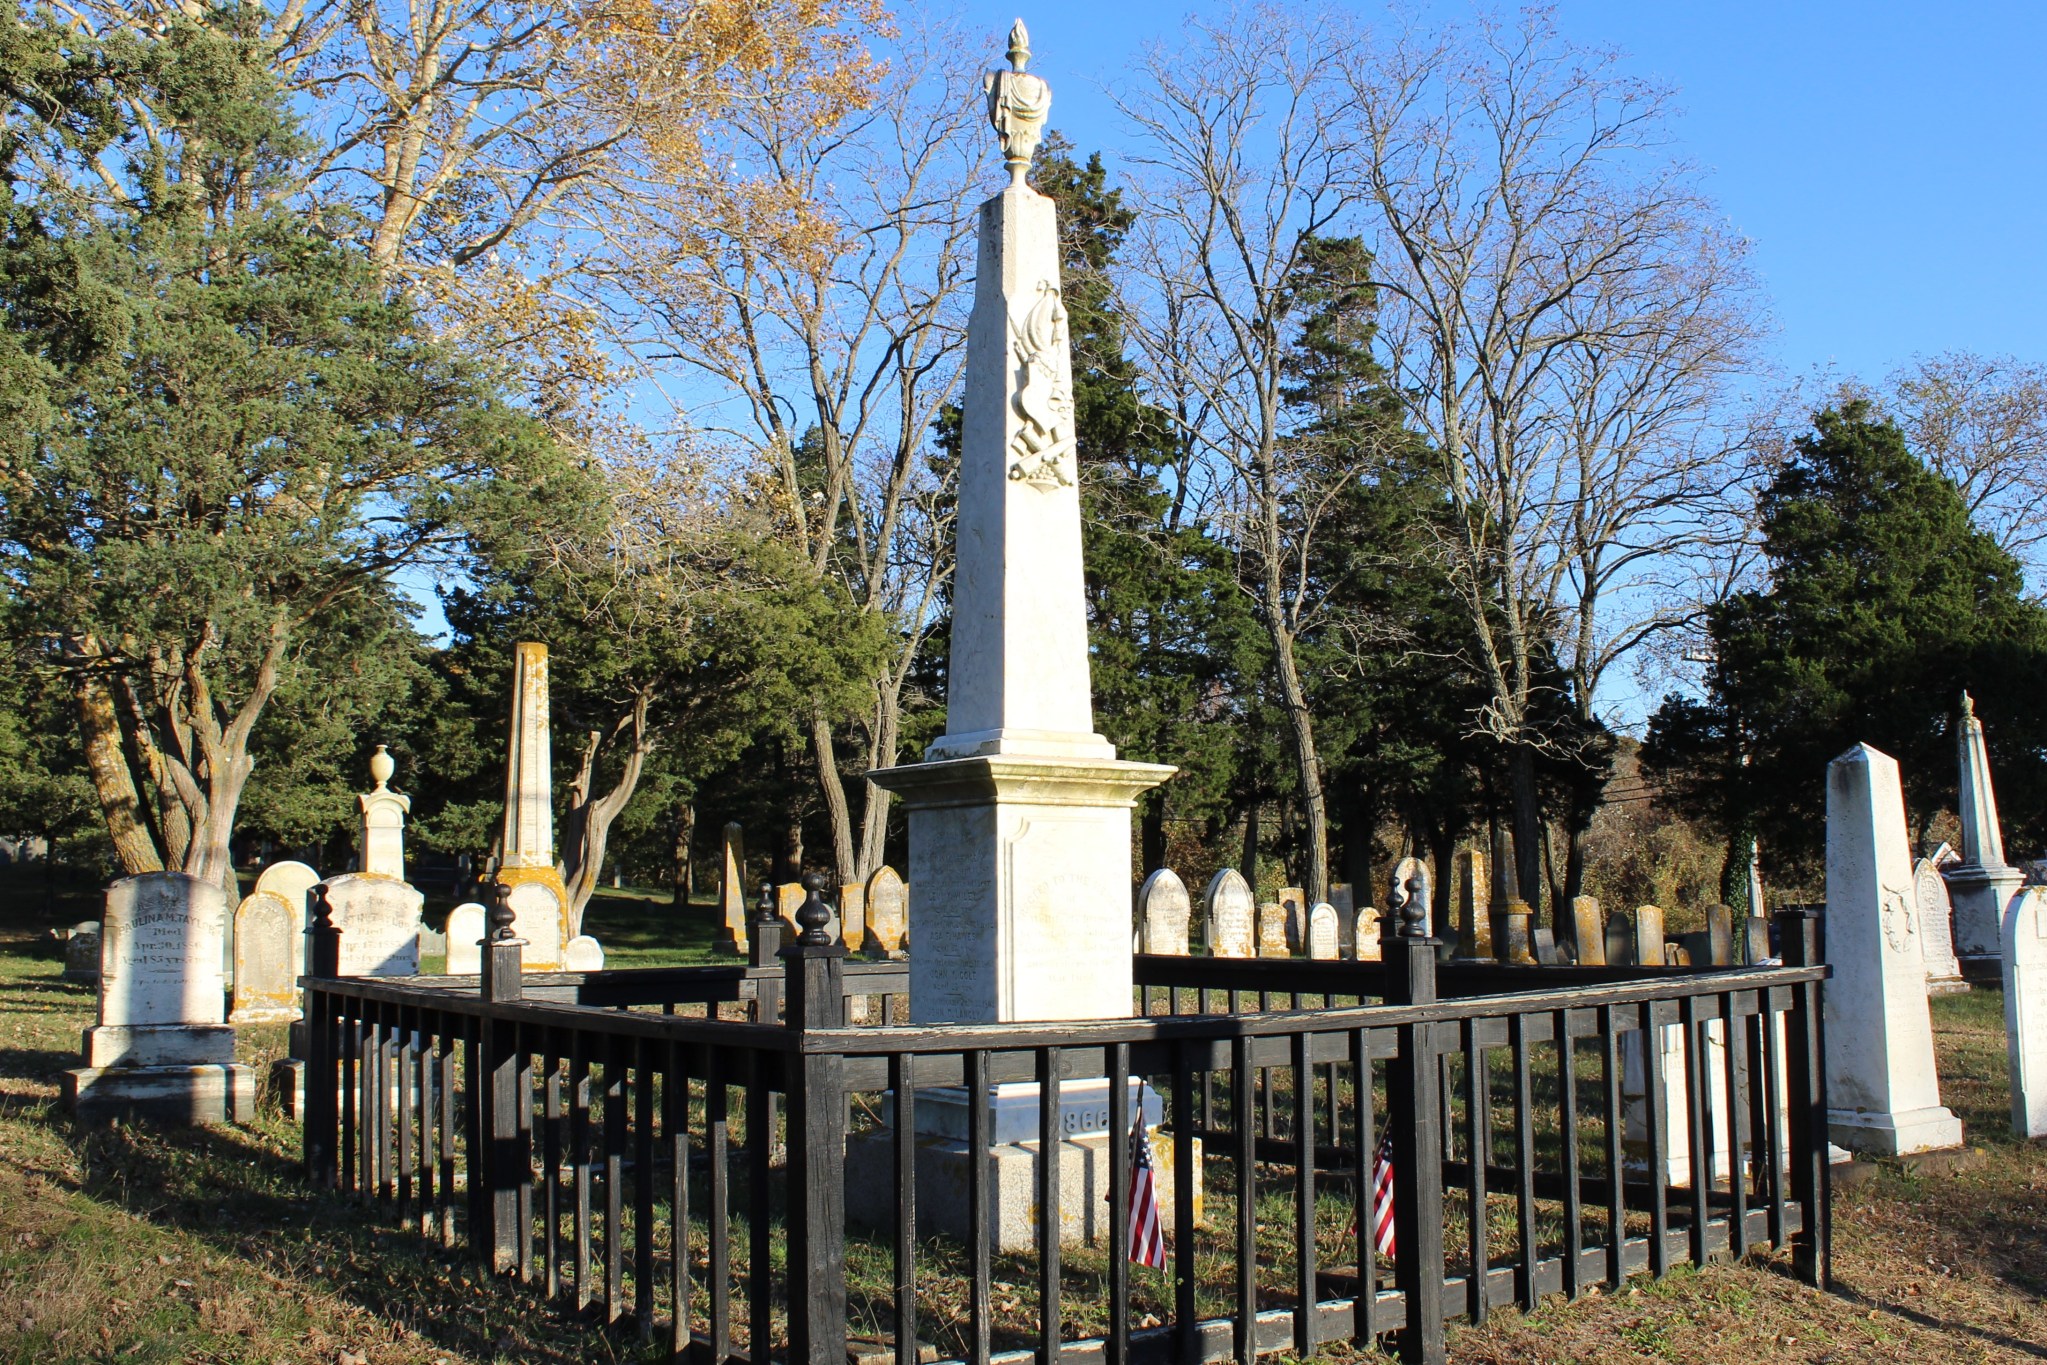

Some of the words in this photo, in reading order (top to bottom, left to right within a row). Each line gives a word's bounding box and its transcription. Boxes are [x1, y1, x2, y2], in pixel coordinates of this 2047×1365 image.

[119, 913, 164, 937] PAULINA
[153, 927, 182, 936] Died
[1064, 1109, 1109, 1134] 866
